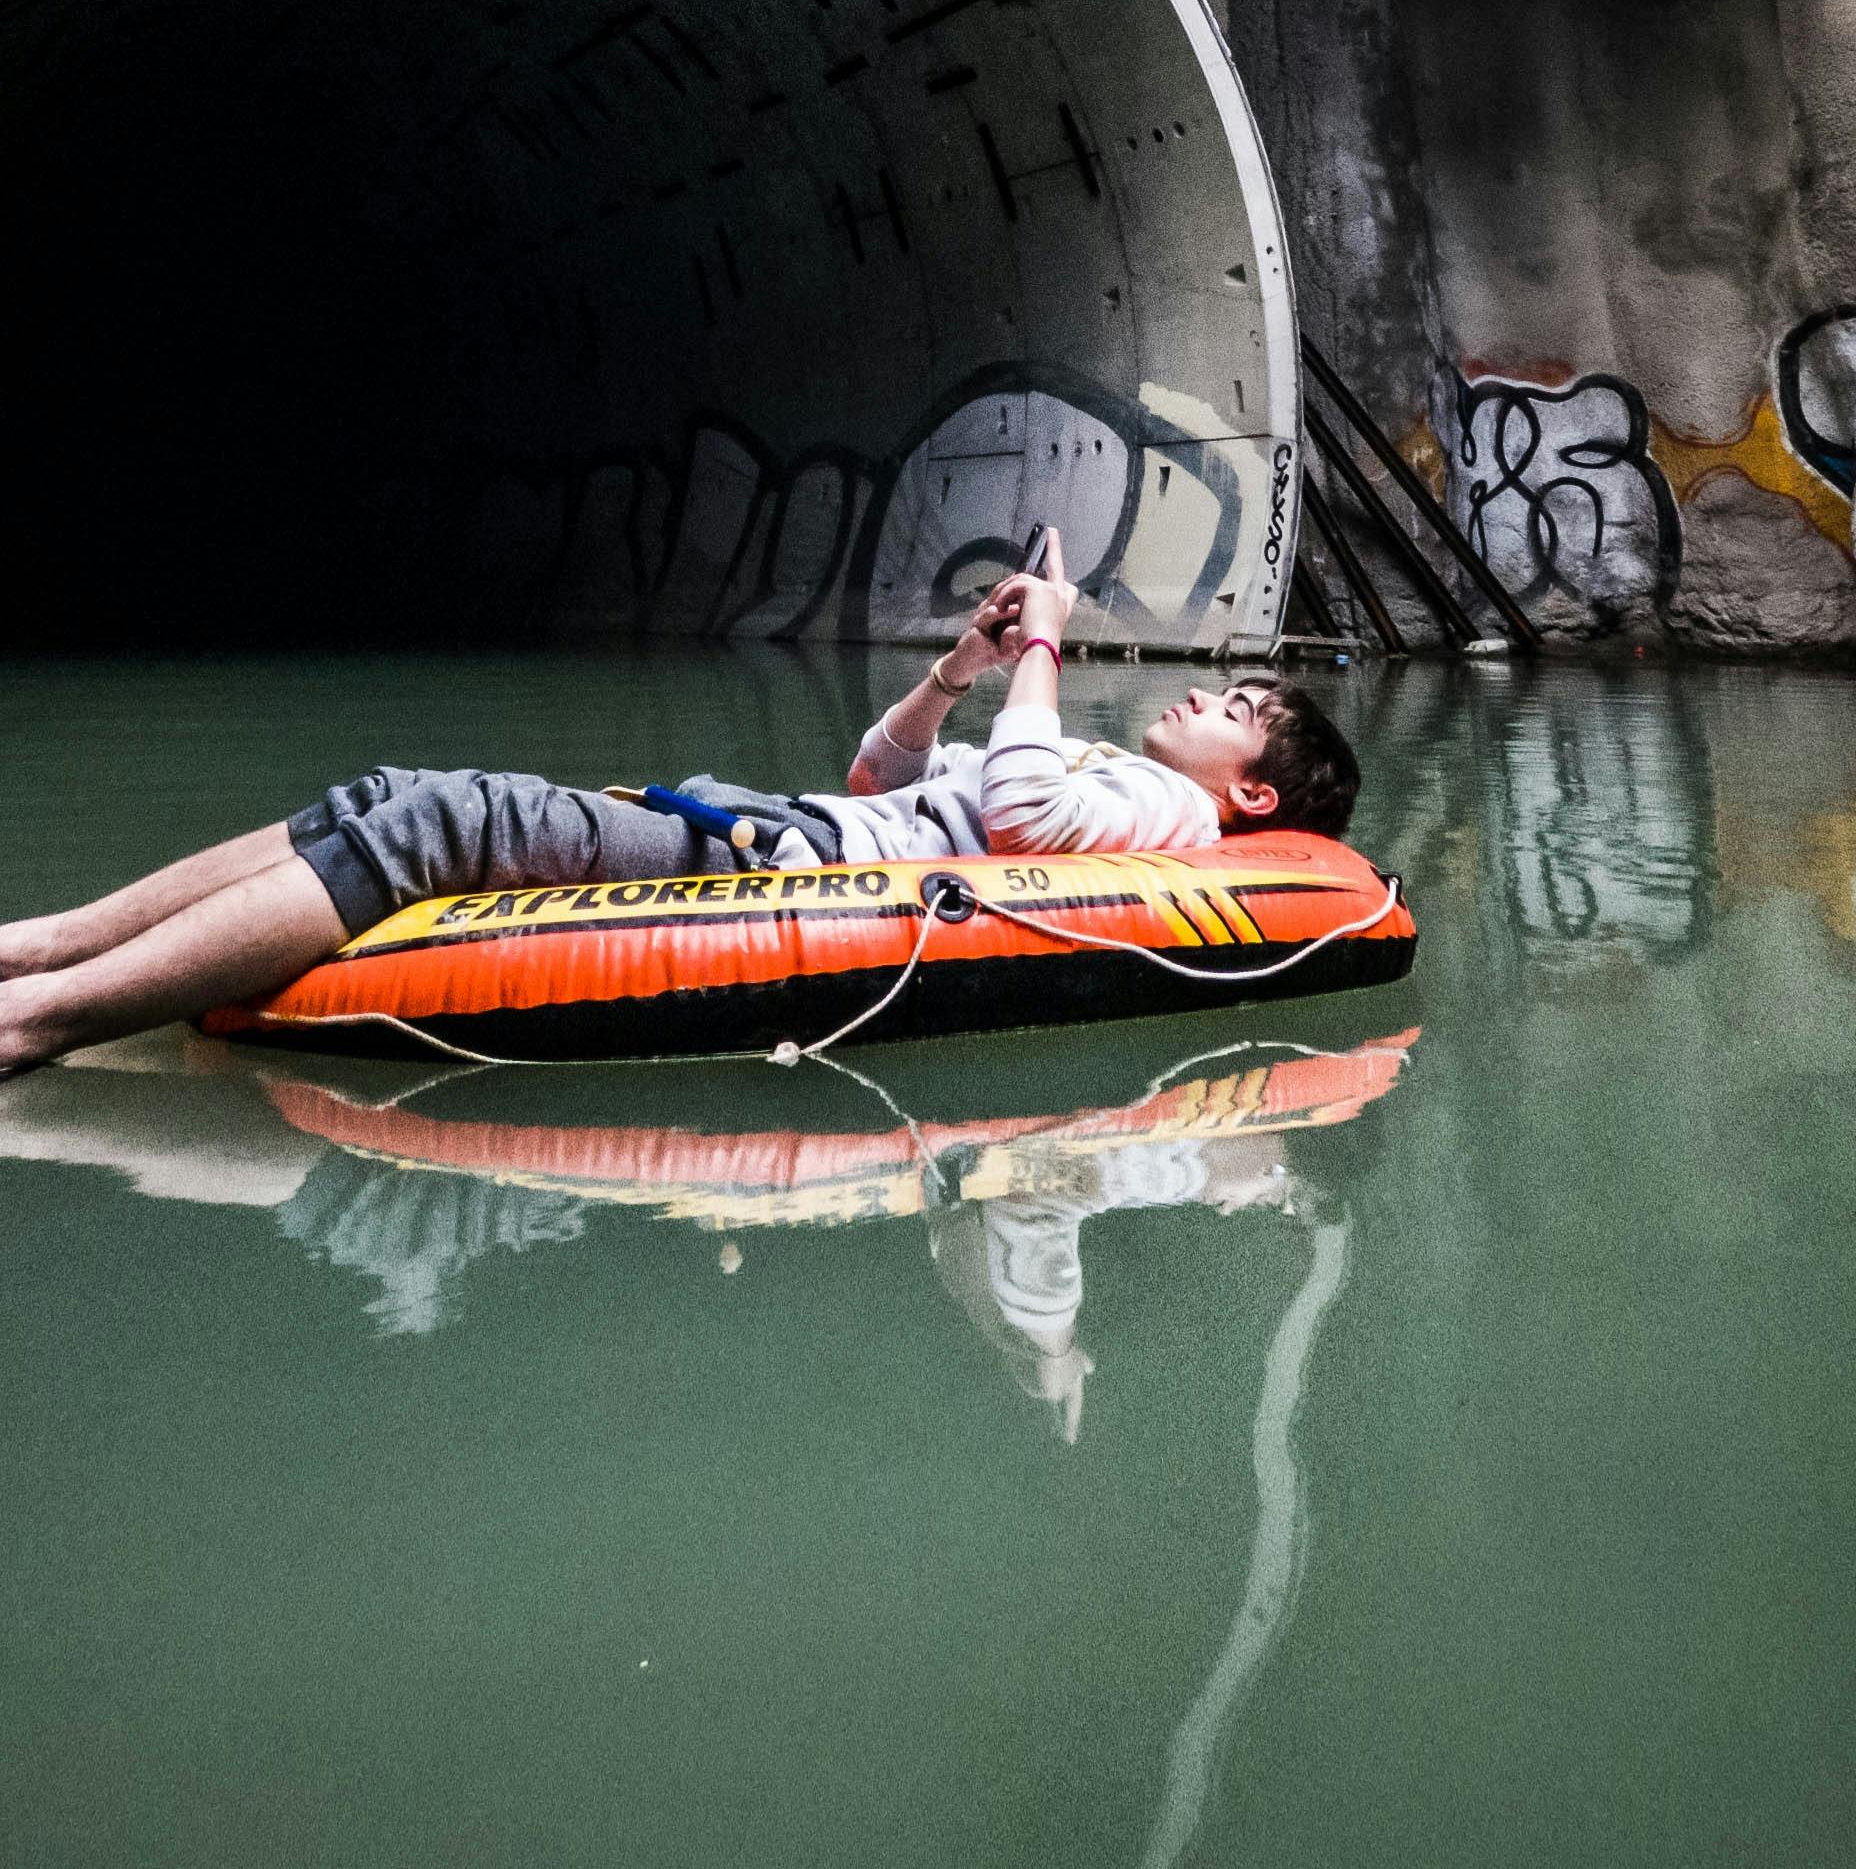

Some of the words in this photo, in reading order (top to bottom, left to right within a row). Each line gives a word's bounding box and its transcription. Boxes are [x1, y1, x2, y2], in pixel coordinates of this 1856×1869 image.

[431, 875, 774, 926] EXPLORER
[779, 870, 891, 900] PRO
[1004, 867, 1051, 892] 50
